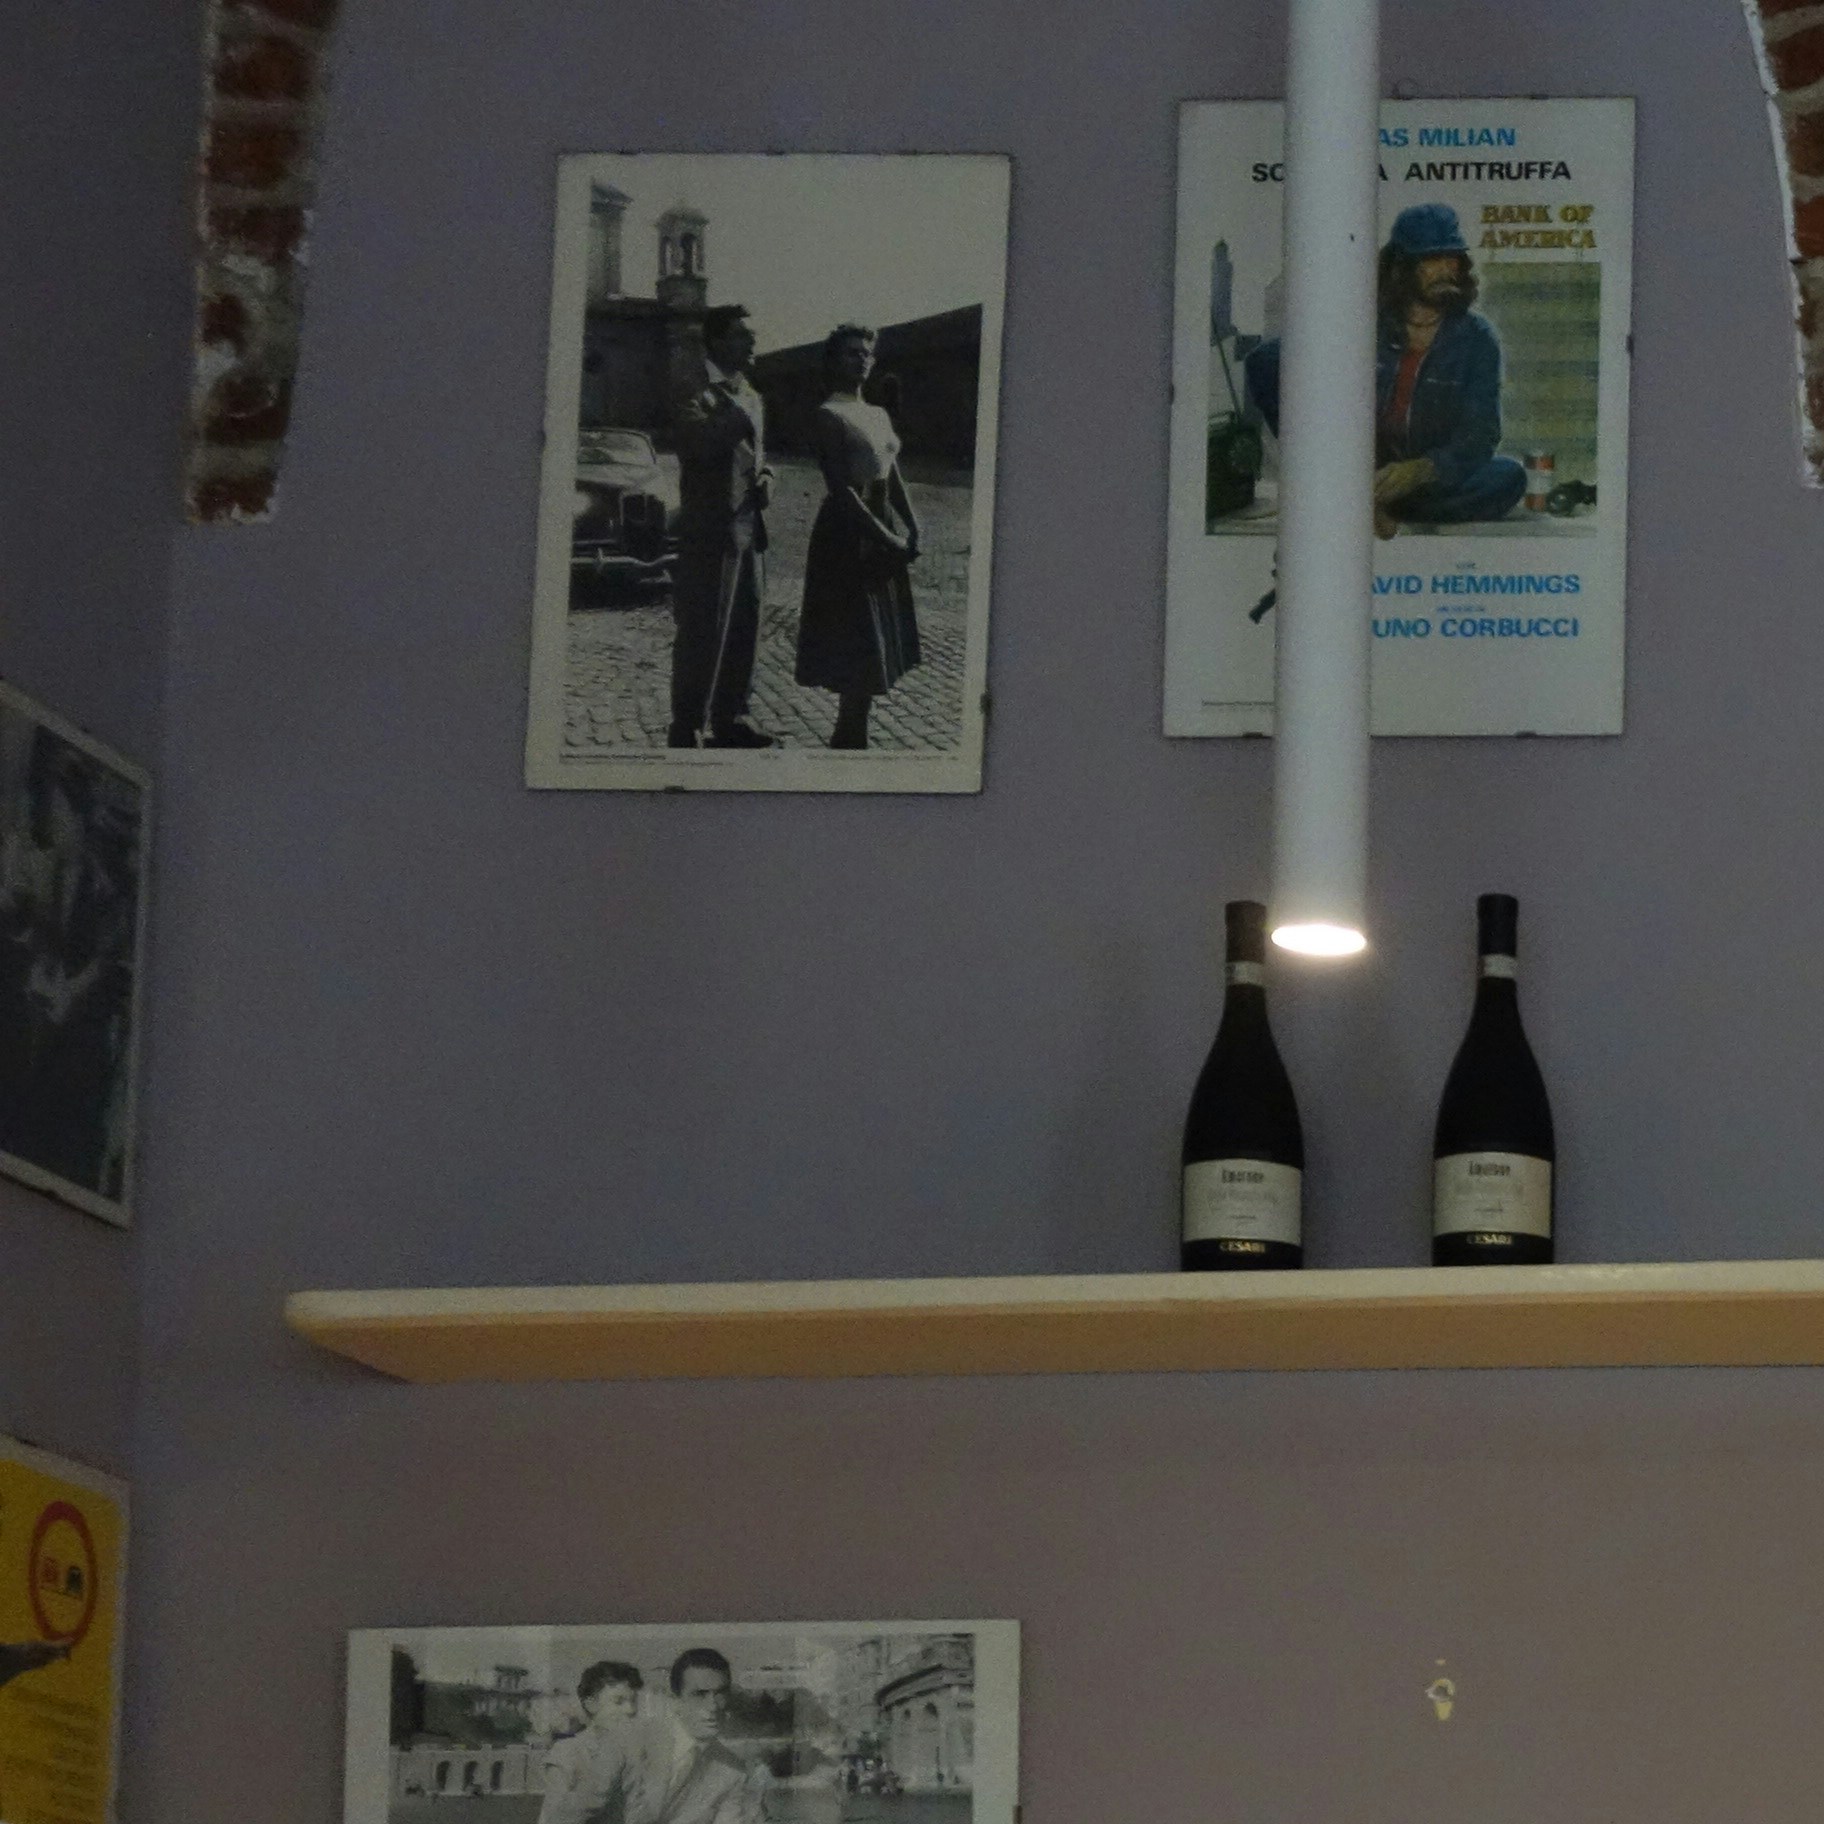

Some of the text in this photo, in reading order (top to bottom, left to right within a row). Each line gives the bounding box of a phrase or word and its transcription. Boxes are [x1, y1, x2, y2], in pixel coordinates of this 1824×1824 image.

[1419, 127, 1517, 148] MILIAN
[1405, 161, 1573, 182] ANTITRUFFA
[1480, 204, 1596, 223] BANK OF
[1480, 229, 1598, 249] AMERICA
[1372, 573, 1582, 595] VID HEMMINGS
[1372, 617, 1581, 639] UNO CORBUCCI
